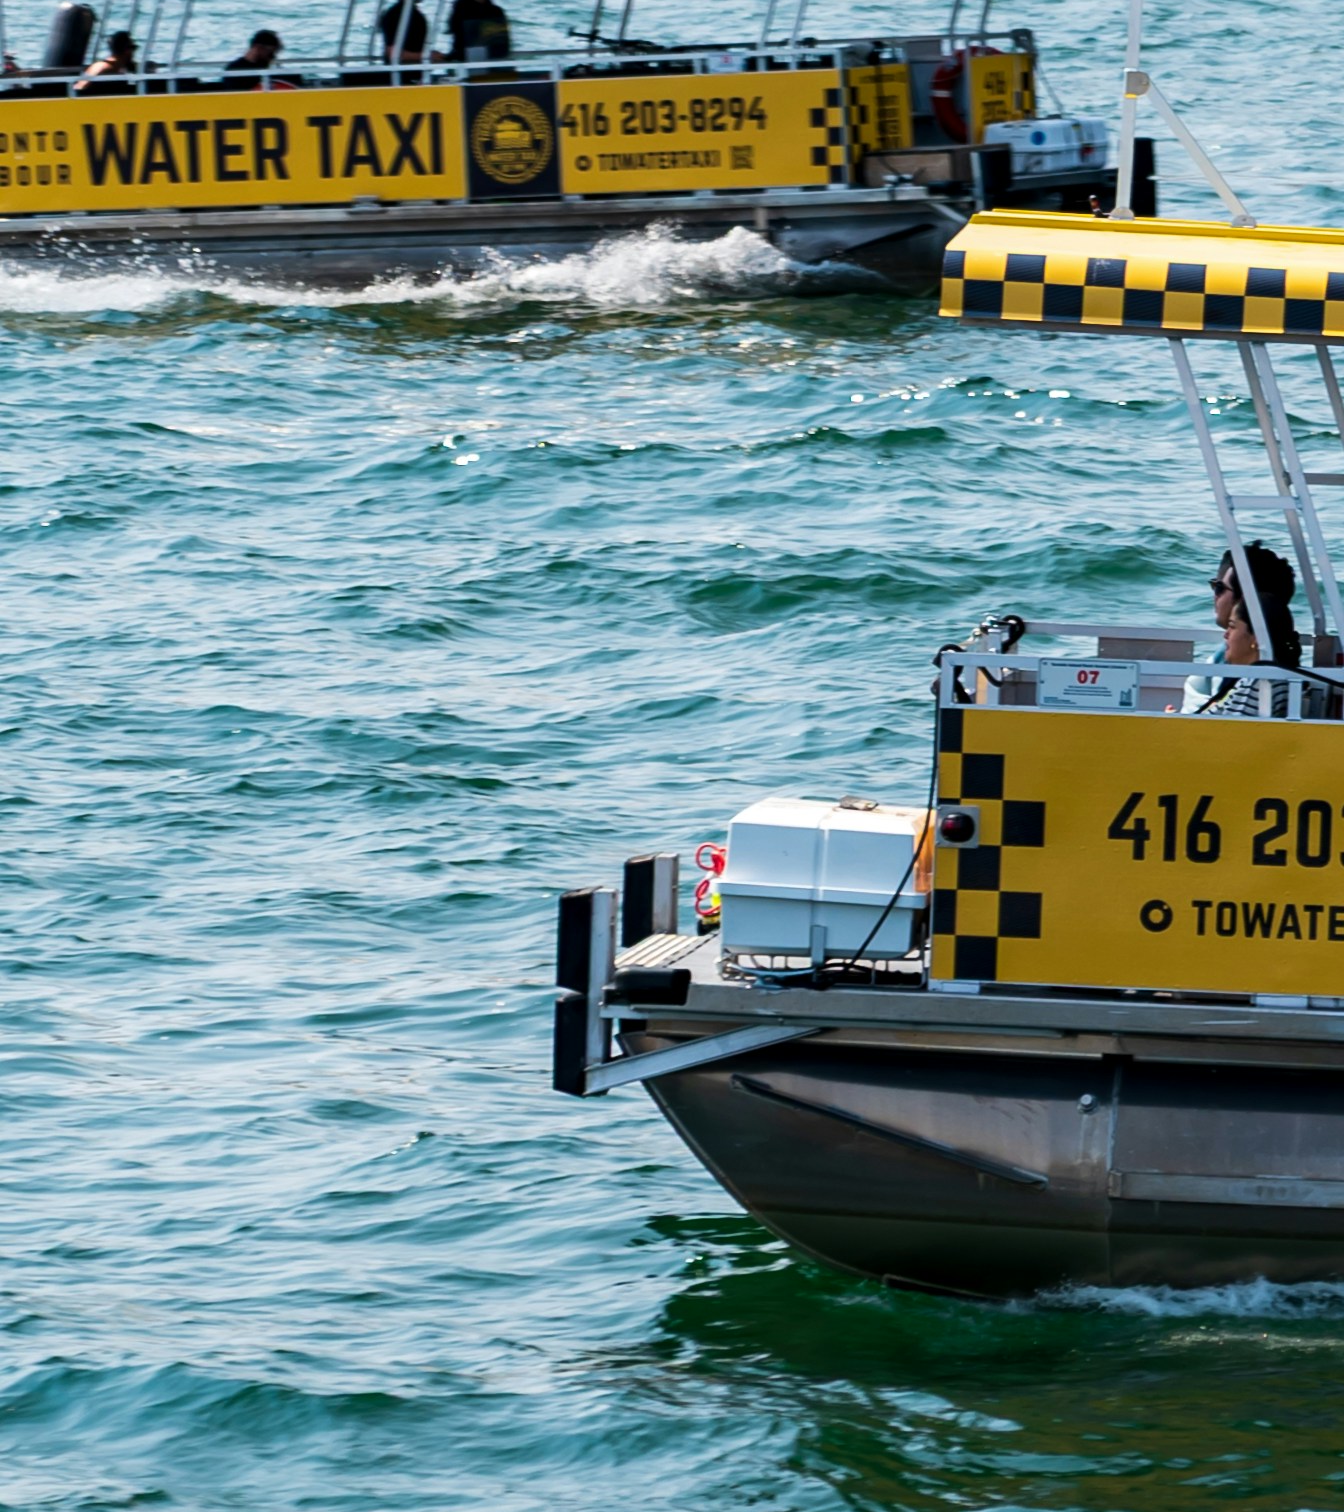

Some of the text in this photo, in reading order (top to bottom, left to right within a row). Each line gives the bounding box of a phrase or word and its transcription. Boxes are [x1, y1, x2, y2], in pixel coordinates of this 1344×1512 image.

[560, 96, 768, 137] 416 203-8294
[82, 118, 289, 185] WATER
[307, 111, 444, 179] TAXI
[1077, 669, 1100, 685] 07
[1108, 792, 1221, 864] 416
